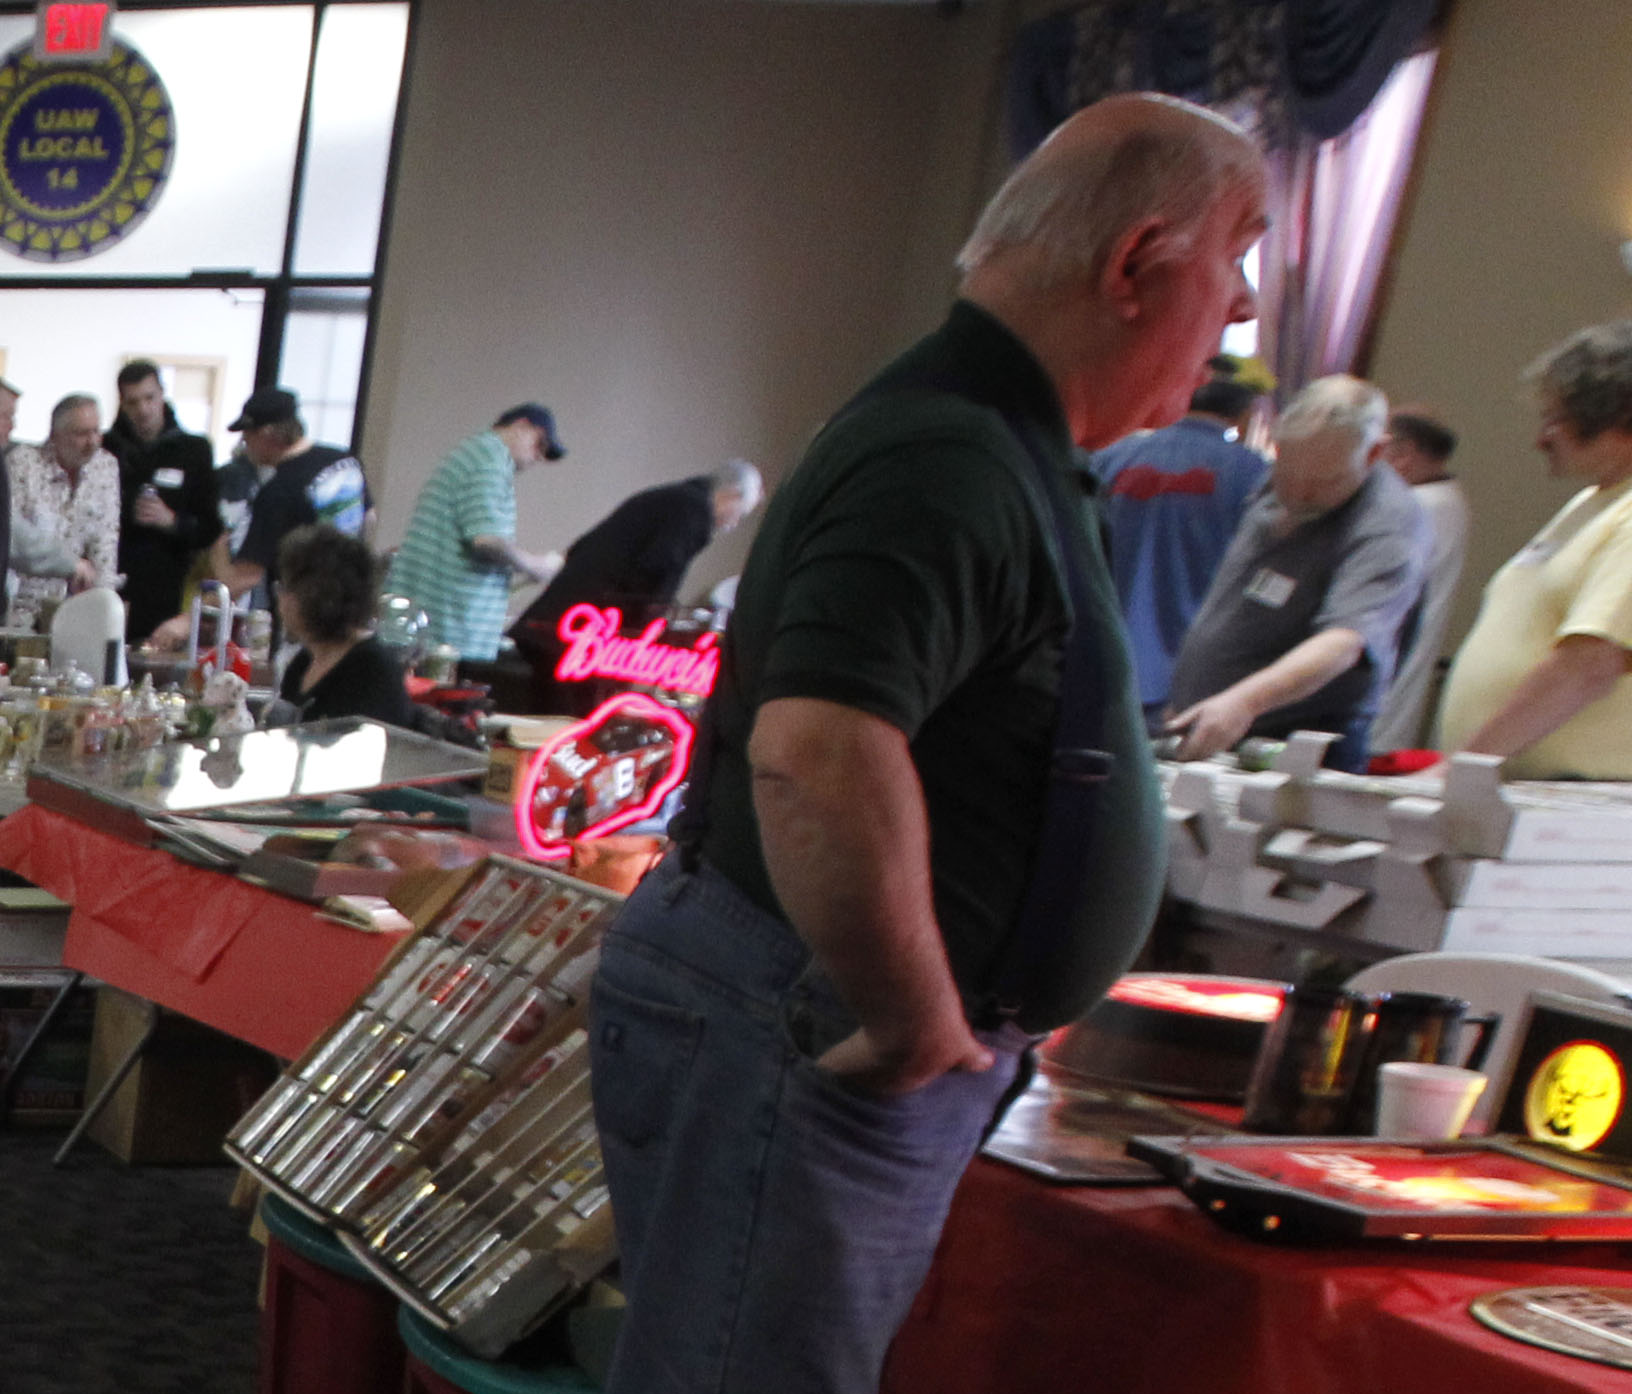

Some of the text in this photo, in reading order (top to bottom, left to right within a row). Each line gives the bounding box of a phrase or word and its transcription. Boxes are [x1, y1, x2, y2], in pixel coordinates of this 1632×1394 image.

[36, 108, 99, 129] UAW
[19, 137, 107, 159] LOCAL
[47, 168, 78, 189] 14
